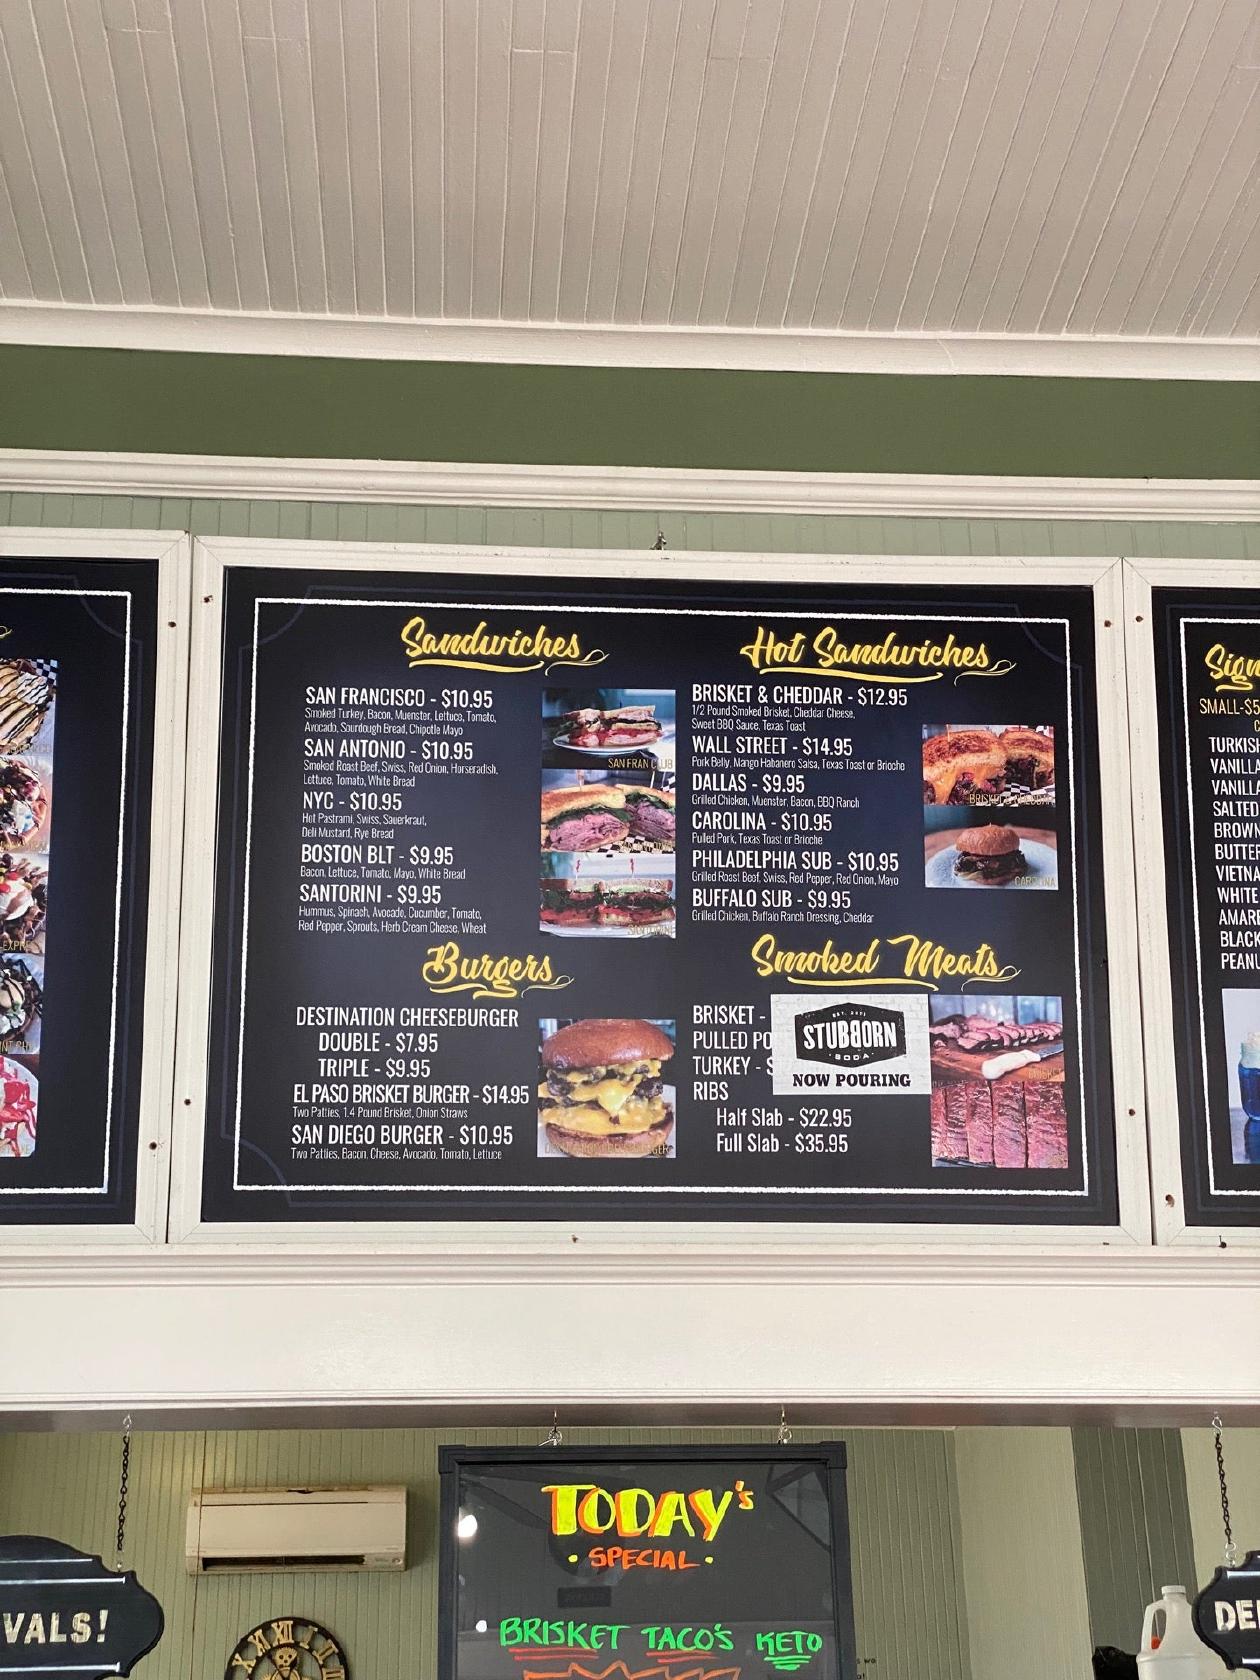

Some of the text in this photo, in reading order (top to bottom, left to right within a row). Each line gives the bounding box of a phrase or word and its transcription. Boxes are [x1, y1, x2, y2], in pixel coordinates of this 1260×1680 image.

[402, 617, 580, 658] Sandwiches
[740, 627, 989, 668] Hot Sandwiches
[306, 687, 492, 708] SAN FRANCISCO $10.95
[693, 684, 907, 706] BRISKET & CHEDDAR $12.95
[305, 707, 496, 723] Smoked Turkey, Muenster, Lettuce, Tomato,
[692, 718, 805, 731] Sweet BBQ Texas Toast
[305, 739, 473, 760] SAN ANTONIO $10.95
[692, 736, 852, 756] WALL STREET $14.95
[608, 758, 649, 769] SAN FRAN
[693, 773, 804, 793] DALLAS $9.95
[304, 791, 402, 811] NYC $10.95
[1213, 801, 1259, 817] SALTED
[693, 811, 832, 831] CAROLINA $10.95
[1214, 822, 1260, 838] BROWN
[301, 844, 453, 865] BOSTON BLT $9.95
[692, 850, 898, 871] PHILADELPHIA SUB $10.95
[1216, 866, 1260, 882] VIETNA
[300, 884, 441, 904] SANTORINI $9.95
[693, 889, 850, 909] BUFFALO SUB $9.95
[1217, 887, 1258, 903] WHITE
[752, 934, 998, 979] Smoked Meats
[422, 941, 552, 999] Burgers
[297, 1007, 518, 1027] DESTINATION CHEESEBURGER
[694, 1005, 754, 1024] BRISKET
[319, 1032, 438, 1053] DOUBLE $7.95
[694, 1031, 772, 1049] PULLED PO
[803, 1020, 897, 1050] STUBBORN
[318, 1058, 430, 1079] TRIPLE $9.95
[693, 1056, 750, 1075] TURKEY
[694, 1082, 728, 1100] RIBS
[792, 1074, 911, 1088] NOW POURING
[294, 1084, 529, 1104] EL PASO BRISKET BURGER $14.95
[717, 1107, 851, 1128] Half Slab $22.95
[292, 1125, 512, 1145] SAN DIEGO BURGER $10.95
[717, 1133, 848, 1153] Full Slab $35.95
[589, 1547, 700, 1570] SPECIAL
[1215, 1600, 1260, 1631] DE
[3, 1610, 108, 1644] VALS!
[500, 1617, 822, 1653] BRISKET TACO'S KETO
